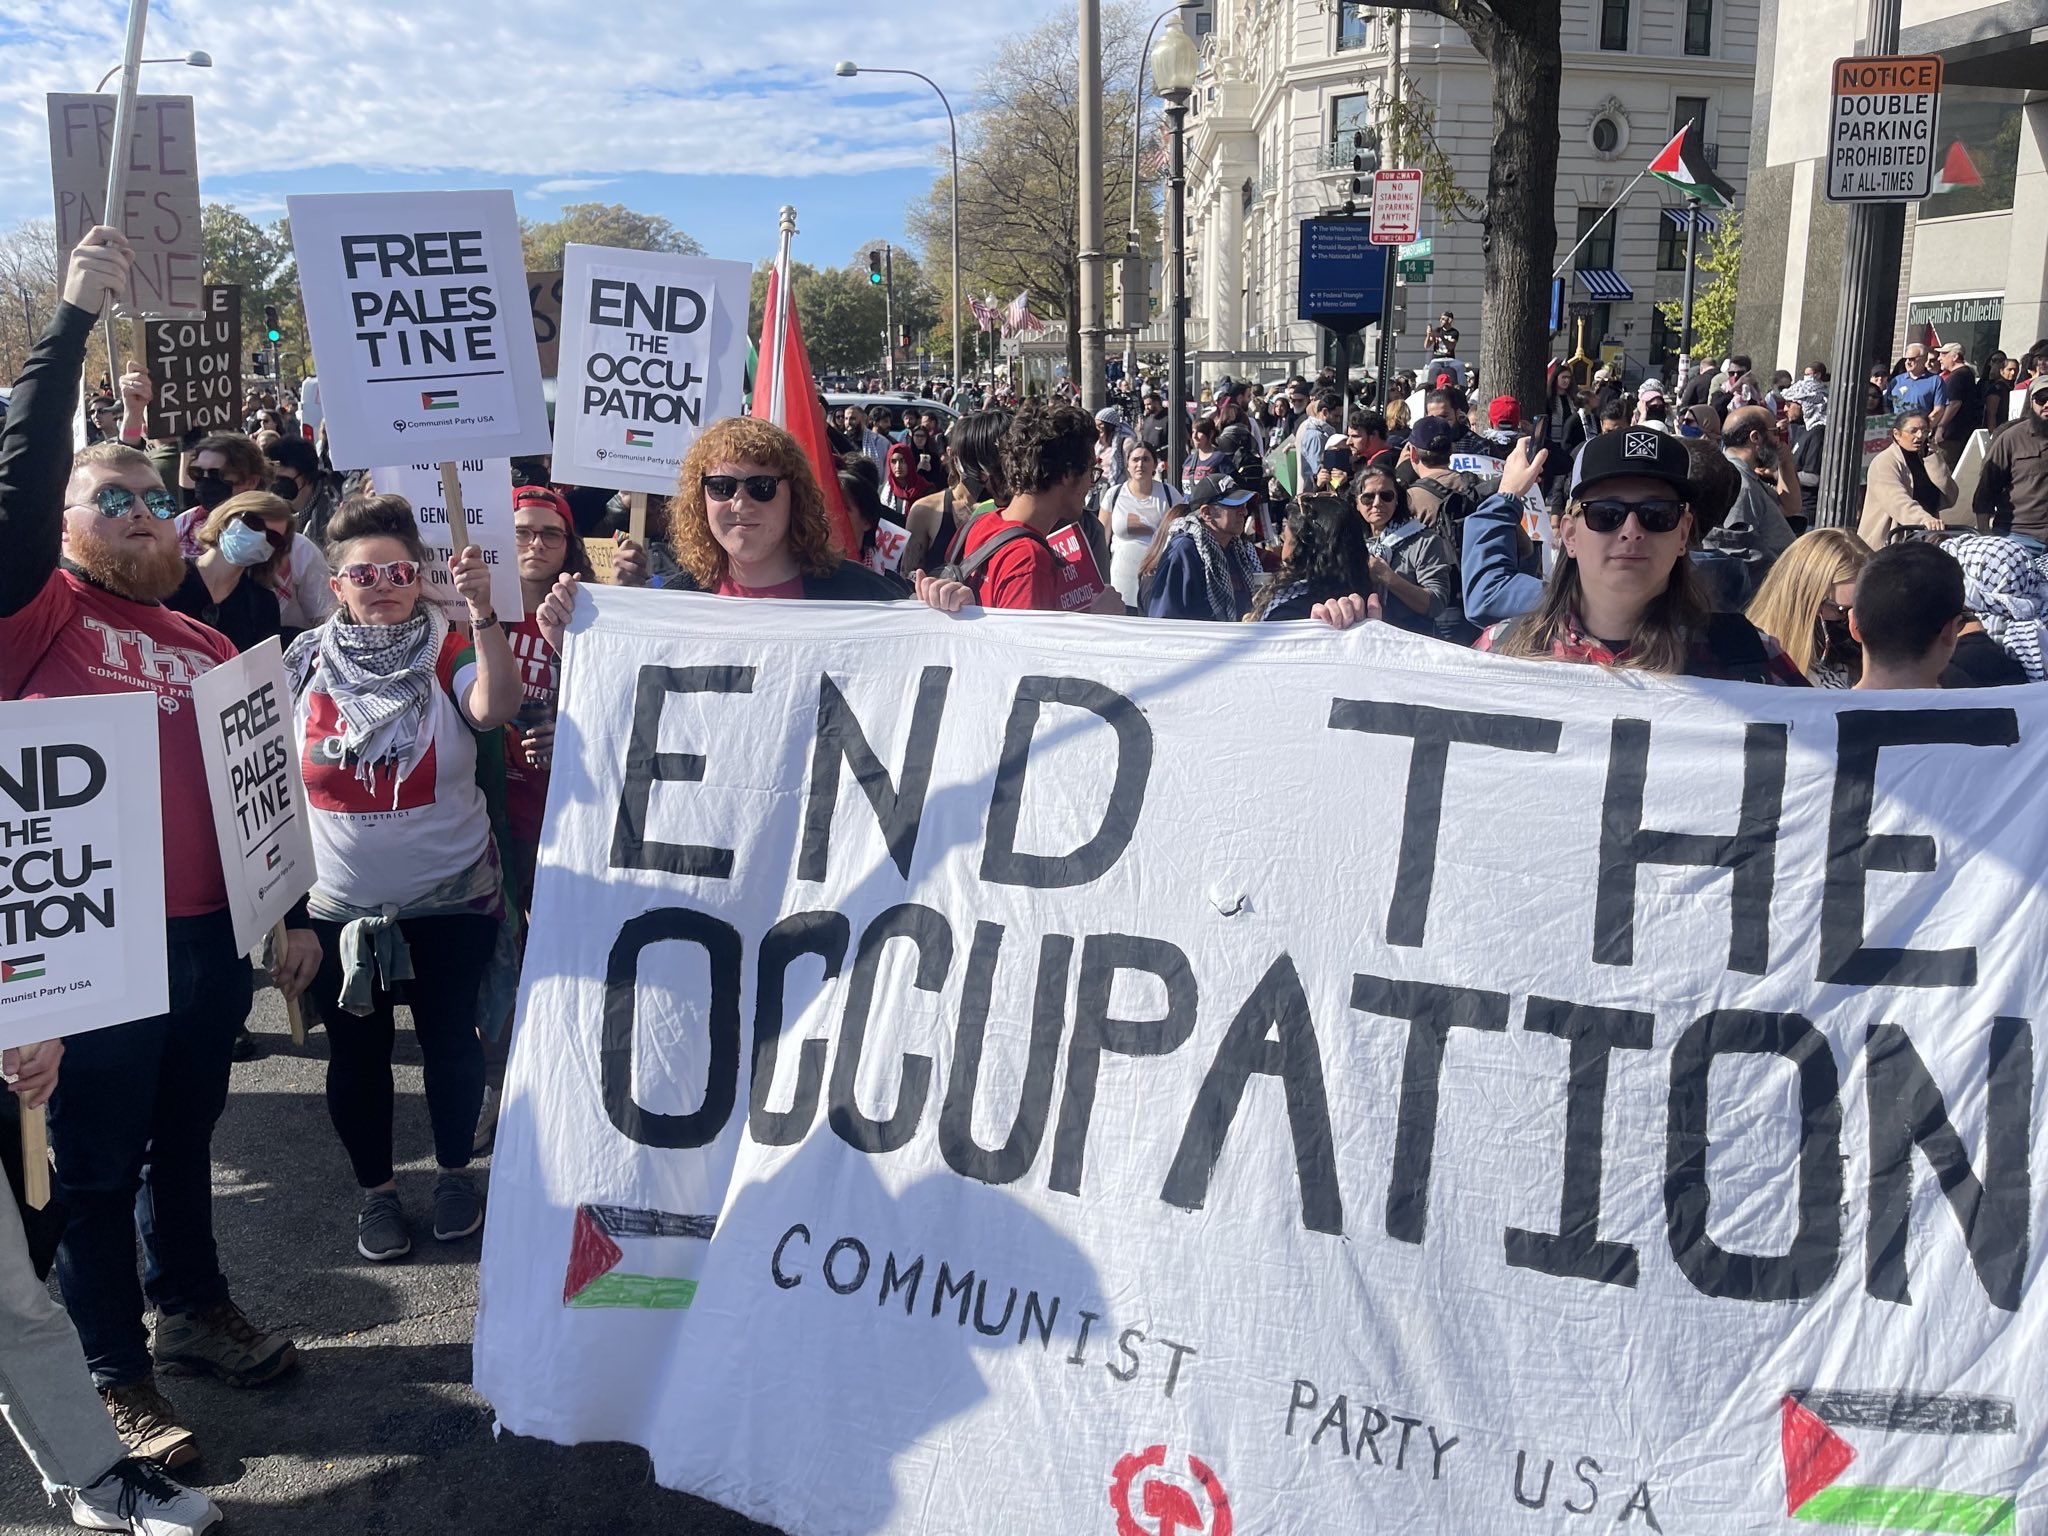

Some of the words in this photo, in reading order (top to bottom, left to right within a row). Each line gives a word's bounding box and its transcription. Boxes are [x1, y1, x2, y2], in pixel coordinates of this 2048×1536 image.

[1843, 66, 1932, 88] NOTICE
[1841, 94, 1928, 116] DOUBLE
[1838, 120, 1928, 141] PARKING
[1836, 146, 1926, 167] PROHIBITED
[1382, 172, 1395, 180] TOW
[1392, 182, 1403, 191] NO
[1841, 173, 1854, 192] AT
[1380, 193, 1413, 201] STANDING
[1385, 203, 1414, 211] PARKING
[60, 191, 193, 246] PAES-
[341, 230, 488, 279] FREE
[1405, 261, 1416, 272] 14
[351, 285, 497, 327] PALES
[590, 278, 707, 334] END
[1911, 302, 1952, 325] Souvenirs
[1954, 301, 1961, 323] &
[158, 322, 230, 353] SOLU
[356, 325, 497, 367] TINE
[626, 332, 669, 355] THE
[158, 353, 230, 380] TION
[587, 352, 703, 391] OCCU-
[160, 374, 233, 404] REVO
[160, 401, 232, 435] TION
[583, 385, 702, 427] PATION
[407, 418, 453, 428] Communist
[455, 417, 475, 425] Party
[477, 415, 495, 423] USA
[608, 451, 645, 462] Communist
[647, 456, 664, 465] Party
[1066, 535, 1080, 554] AID
[1063, 564, 1078, 583] FOR
[1061, 582, 1094, 609] GENOCIDE
[88, 665, 164, 694] COMMUNIST
[220, 681, 281, 757] FREE
[231, 734, 288, 804] PALES
[237, 772, 291, 841] TINE
[361, 810, 410, 821] DISTRICT
[610, 665, 1154, 889] END
[1328, 697, 2020, 988] THE
[0, 887, 115, 947] TION
[39, 985, 67, 997] Party
[69, 979, 92, 991] USA
[601, 903, 2032, 1311] OCCUPATION
[772, 1223, 1197, 1398] COMMUNIST
[1285, 1379, 1459, 1480] PARTY
[1514, 1449, 1663, 1536] USA
